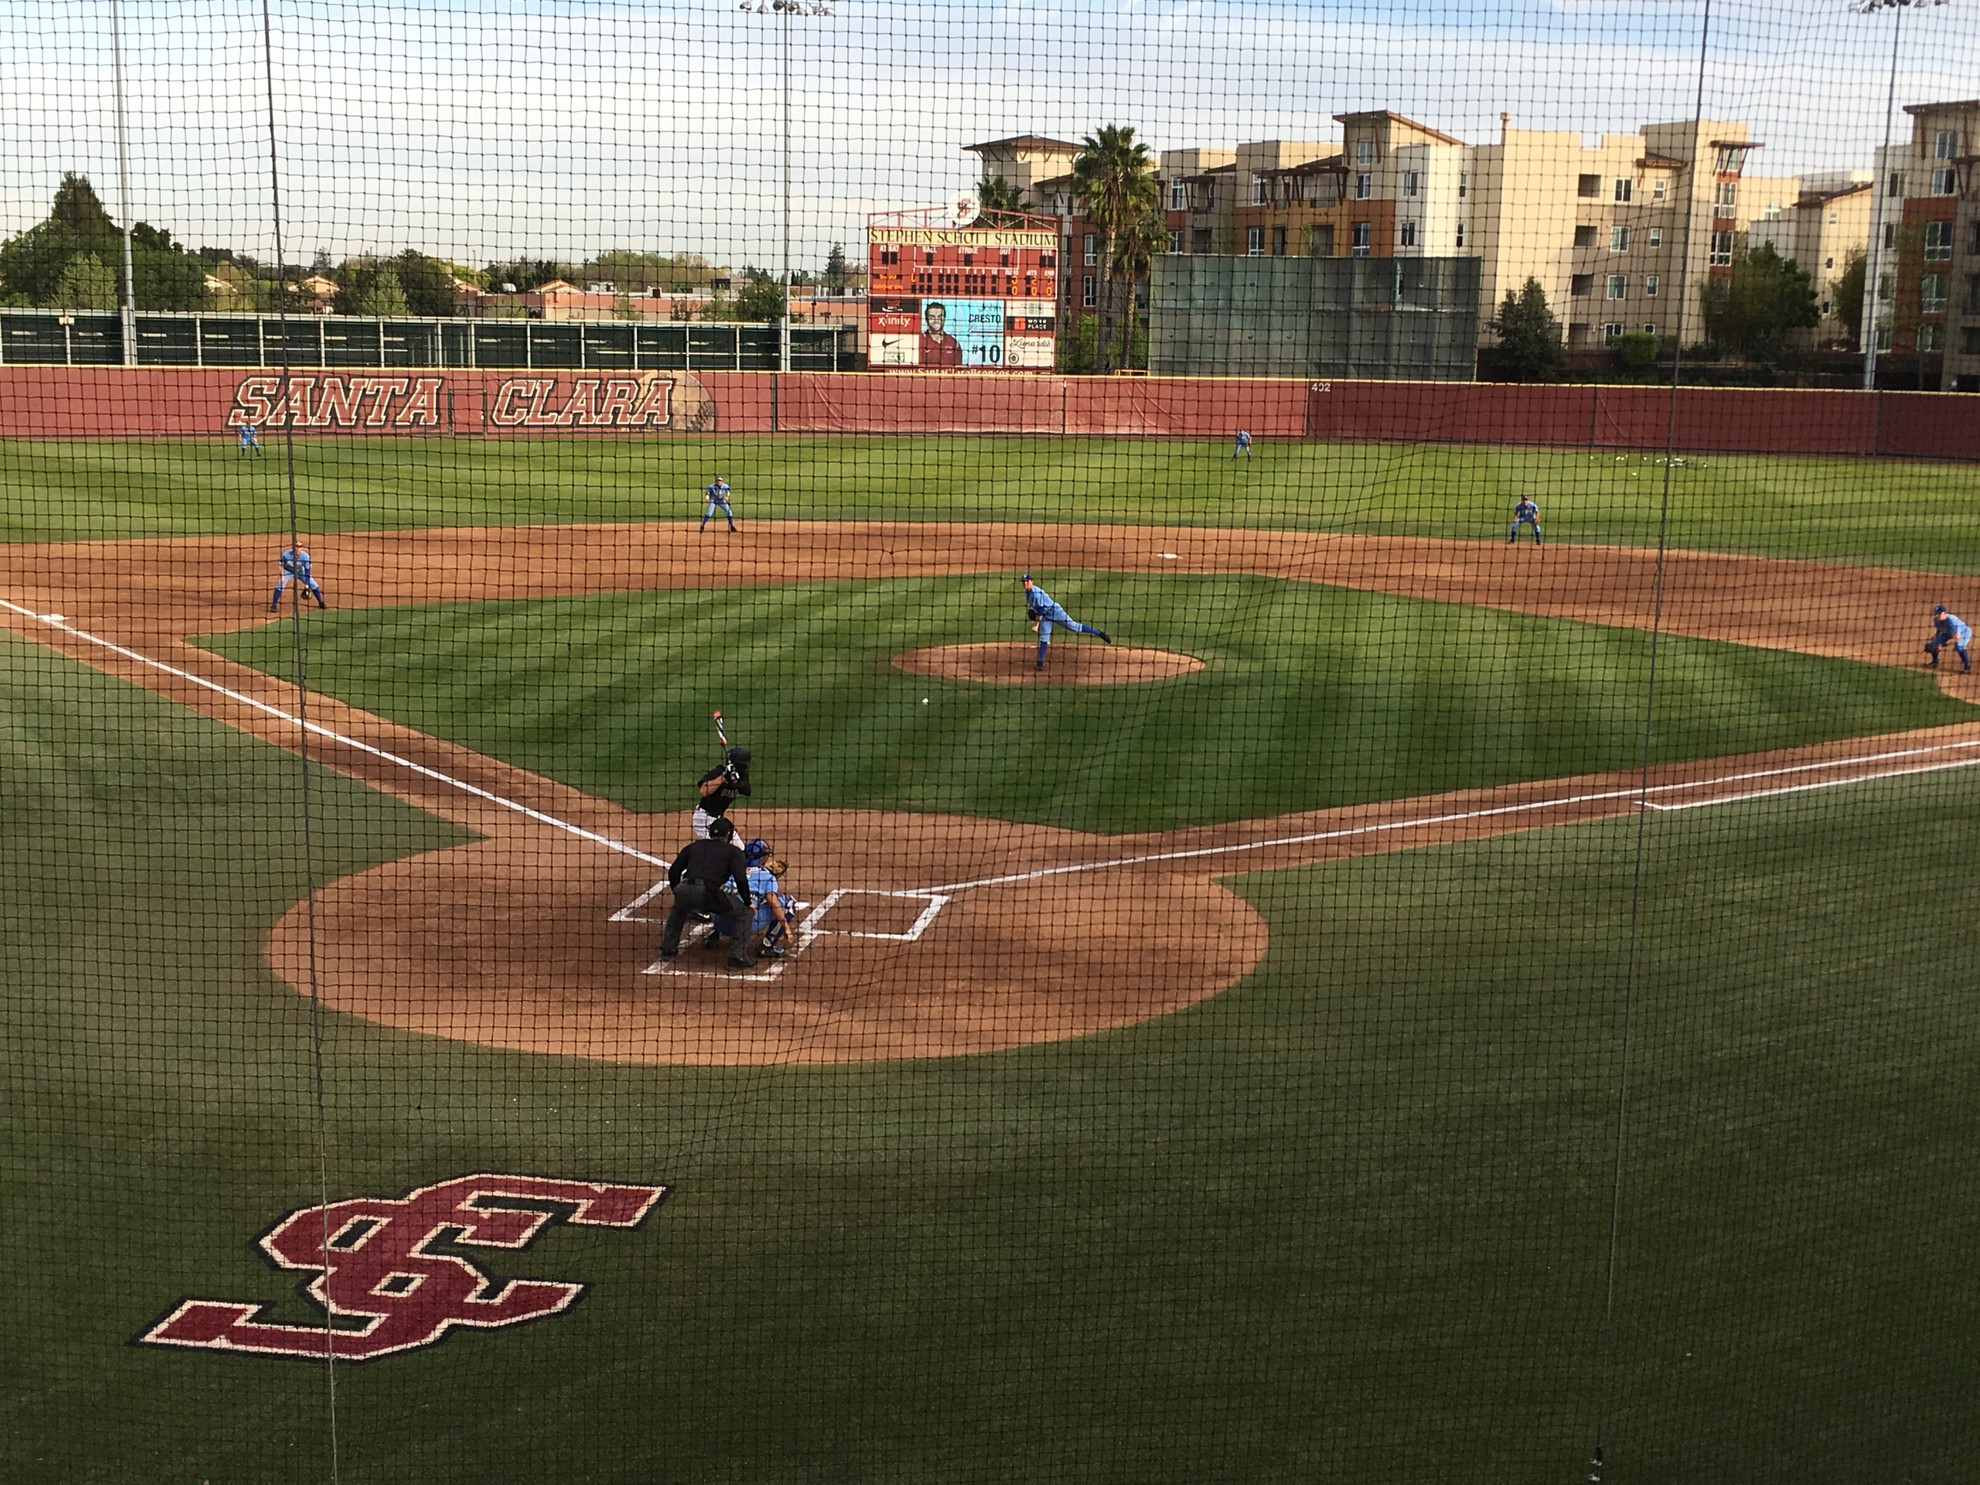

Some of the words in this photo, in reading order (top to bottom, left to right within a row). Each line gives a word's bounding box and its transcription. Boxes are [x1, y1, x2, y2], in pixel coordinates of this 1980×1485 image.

[871, 229, 932, 243] STEPHEN
[937, 231, 988, 244] SCHOTT
[995, 232, 1056, 246] STADIUM
[958, 246, 978, 254] STRIKE
[1012, 286, 1018, 296] 0
[1031, 287, 1037, 296] 0
[1046, 287, 1053, 296] 0
[969, 314, 1002, 323] CRESTO
[972, 344, 1000, 363] #10
[1311, 383, 1331, 392] 402
[227, 377, 444, 428] SANTA
[490, 377, 674, 428] CLARA
